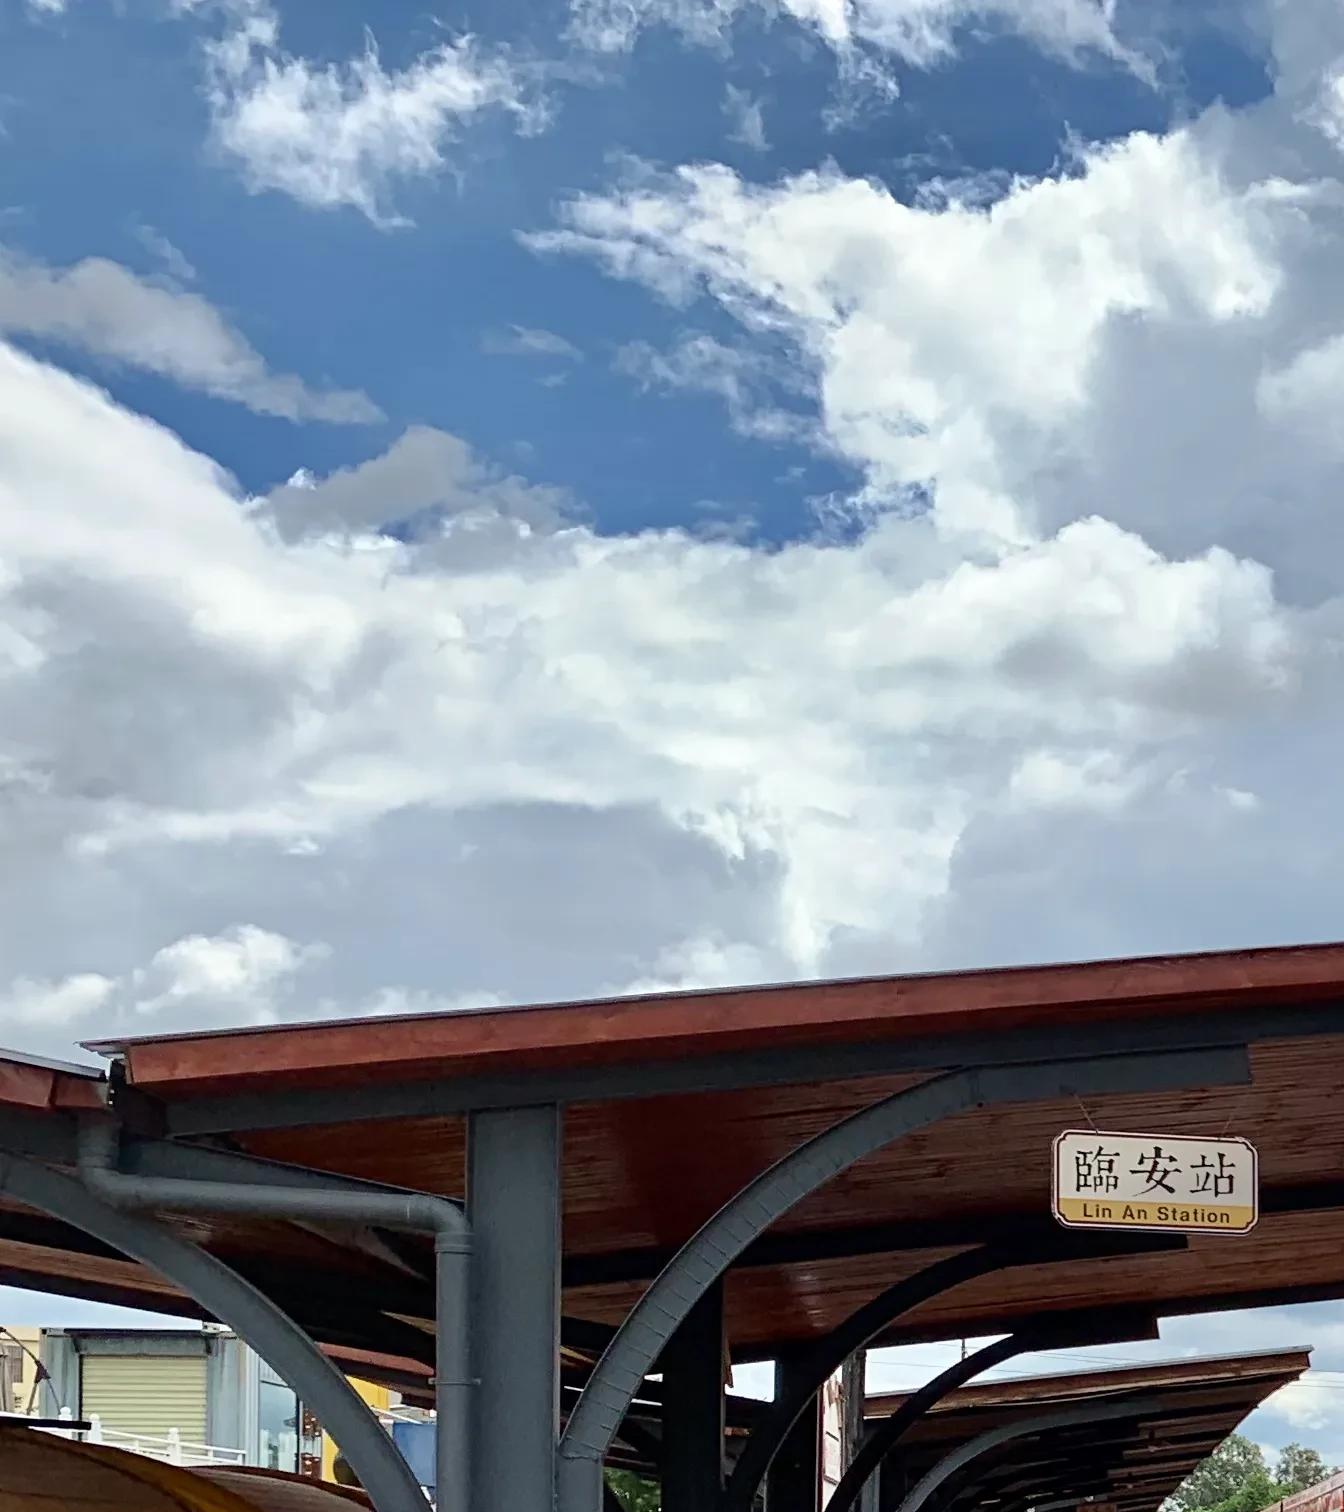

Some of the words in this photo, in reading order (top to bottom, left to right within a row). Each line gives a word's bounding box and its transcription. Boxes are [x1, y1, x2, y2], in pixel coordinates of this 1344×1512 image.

[1075, 1146, 1236, 1198] 臨安站
[1083, 1203, 1112, 1219] Lin
[1122, 1204, 1148, 1220] An
[1157, 1206, 1230, 1224] Station
